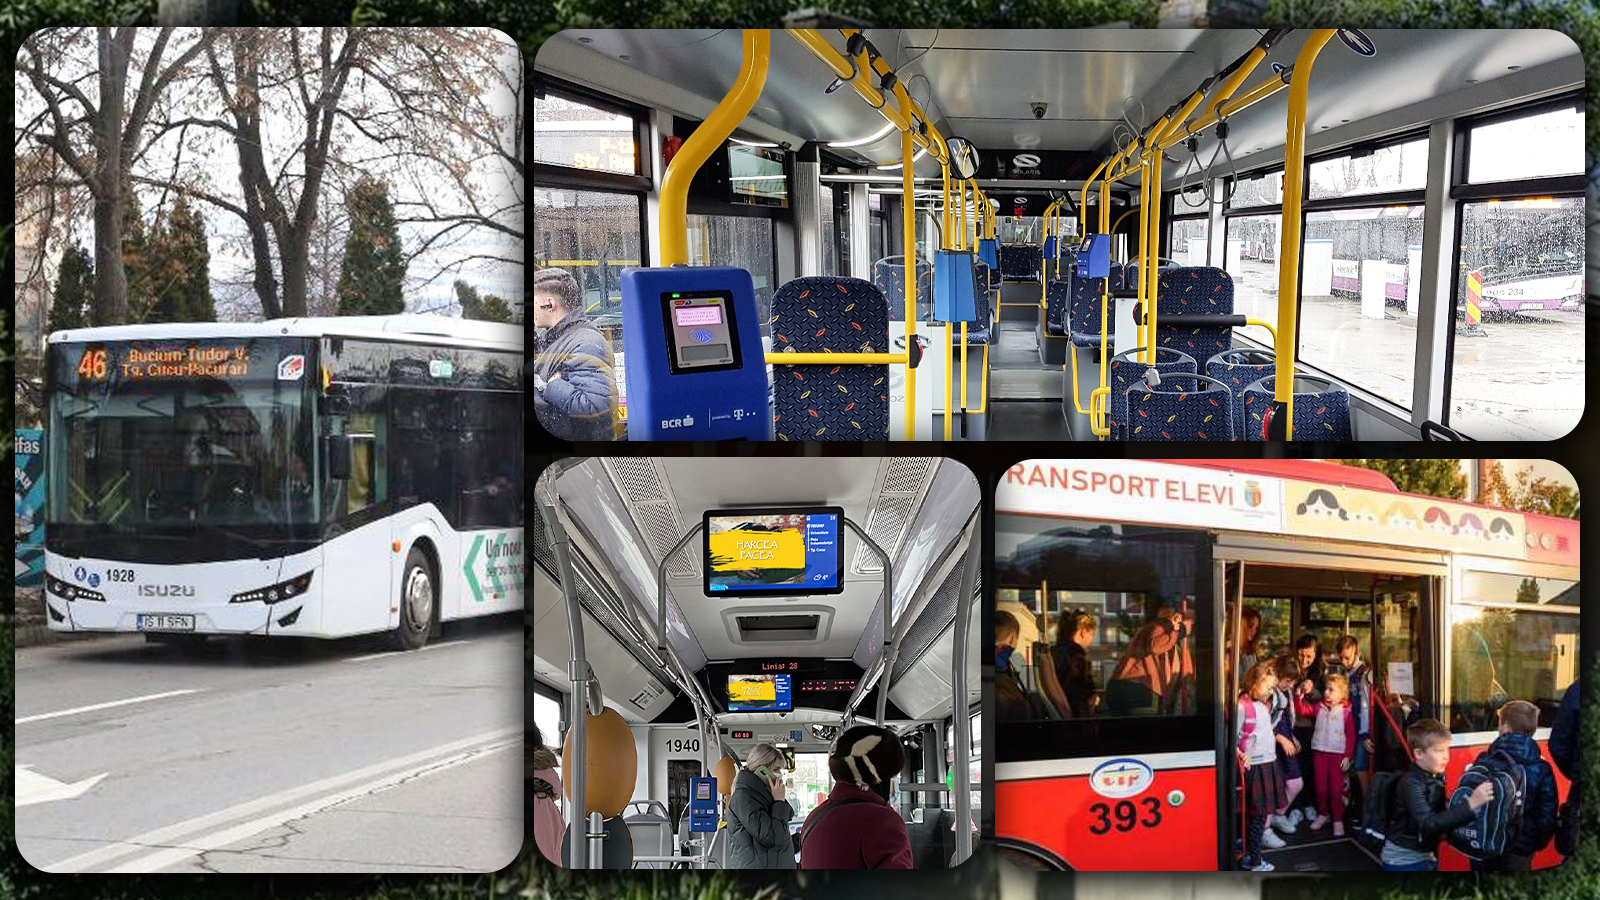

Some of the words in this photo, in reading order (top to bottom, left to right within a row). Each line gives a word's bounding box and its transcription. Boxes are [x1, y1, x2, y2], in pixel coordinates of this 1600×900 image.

[1507, 287, 1524, 296] 234
[78, 350, 106, 379] 46
[661, 417, 682, 430] BCR
[1165, 478, 1234, 506] ELEVI
[736, 540, 779, 550] HARCEA
[106, 569, 135, 583] 1928
[138, 585, 195, 597] ISUZU
[762, 662, 786, 670] Linia:
[789, 662, 798, 670] 28
[665, 739, 700, 752] 1940
[1090, 796, 1163, 835] 393
